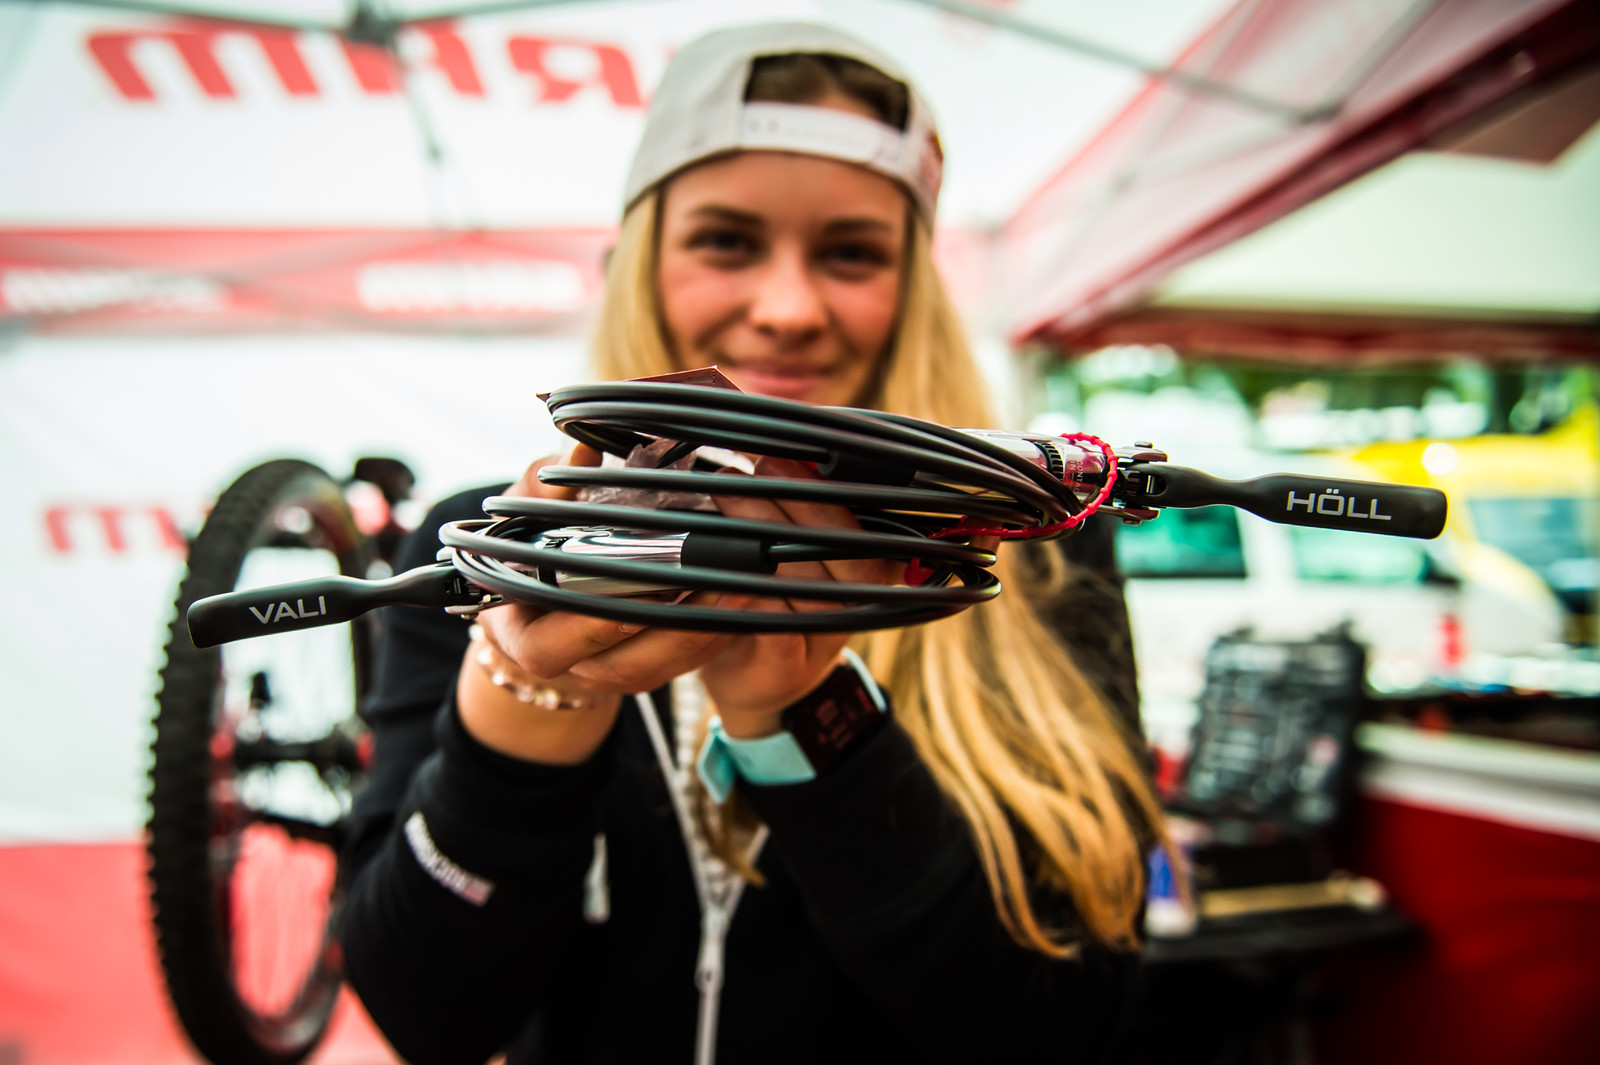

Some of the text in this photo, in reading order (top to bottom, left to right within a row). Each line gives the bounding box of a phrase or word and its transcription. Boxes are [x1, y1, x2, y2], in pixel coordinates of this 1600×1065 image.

[1073, 460, 1084, 493] CONTAC
[1286, 488, 1392, 521] HÖLL
[249, 595, 326, 624] VALI
